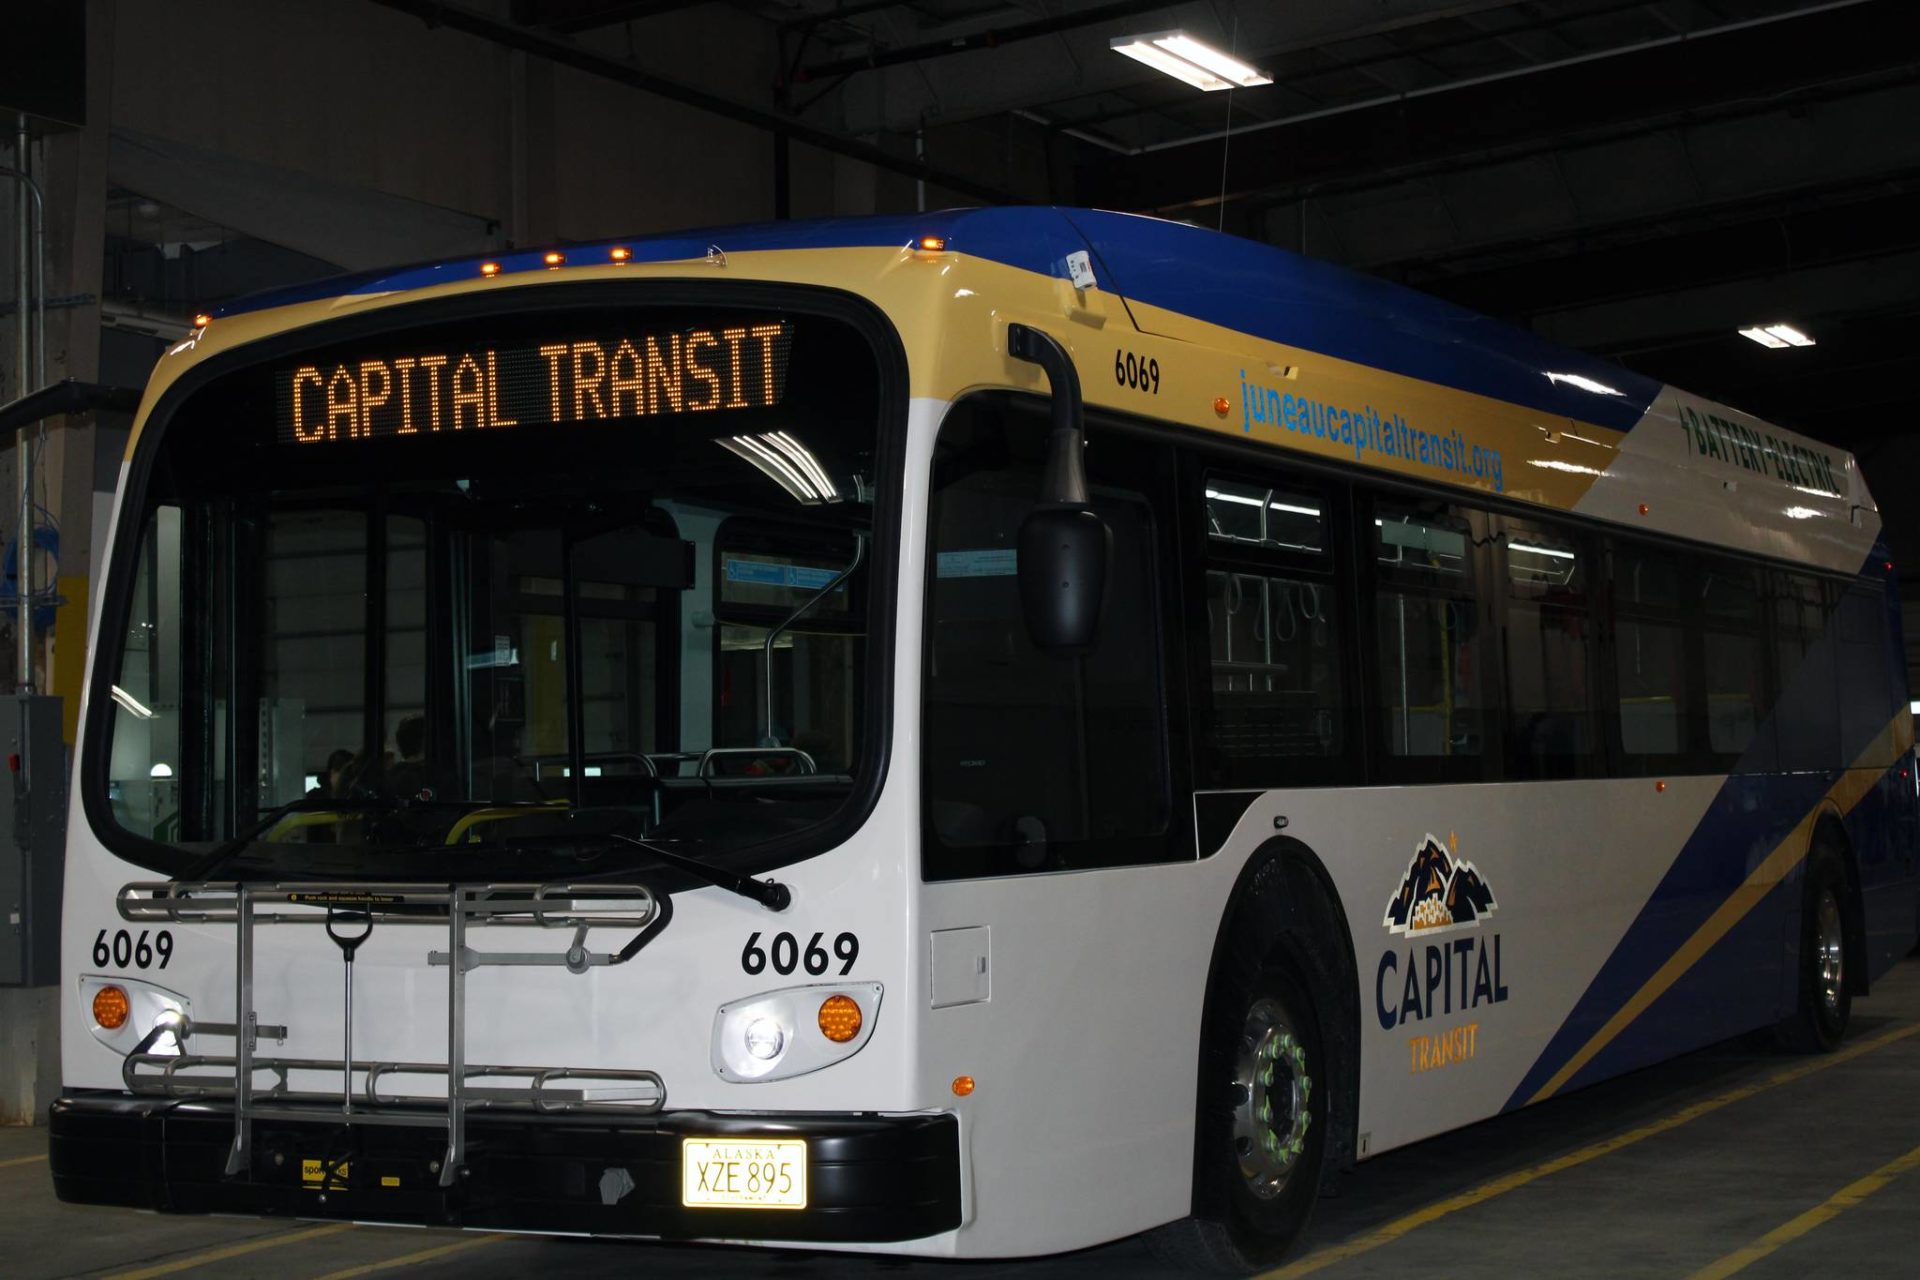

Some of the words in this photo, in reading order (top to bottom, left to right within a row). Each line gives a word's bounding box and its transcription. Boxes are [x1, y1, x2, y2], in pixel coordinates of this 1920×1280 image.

[293, 351, 518, 442] CAPITAL
[539, 325, 782, 421] TRANSIT
[1115, 349, 1159, 394] 6069
[1240, 369, 1504, 493] juneaucapitaltransit.org
[93, 929, 173, 969] 6069
[741, 931, 860, 975] 6069
[1376, 934, 1508, 1030] CAPITAL
[1409, 1022, 1479, 1074] TRANSIT
[712, 1148, 775, 1159] ALASKA
[697, 1161, 741, 1193] XZE
[747, 1162, 792, 1194] 895
